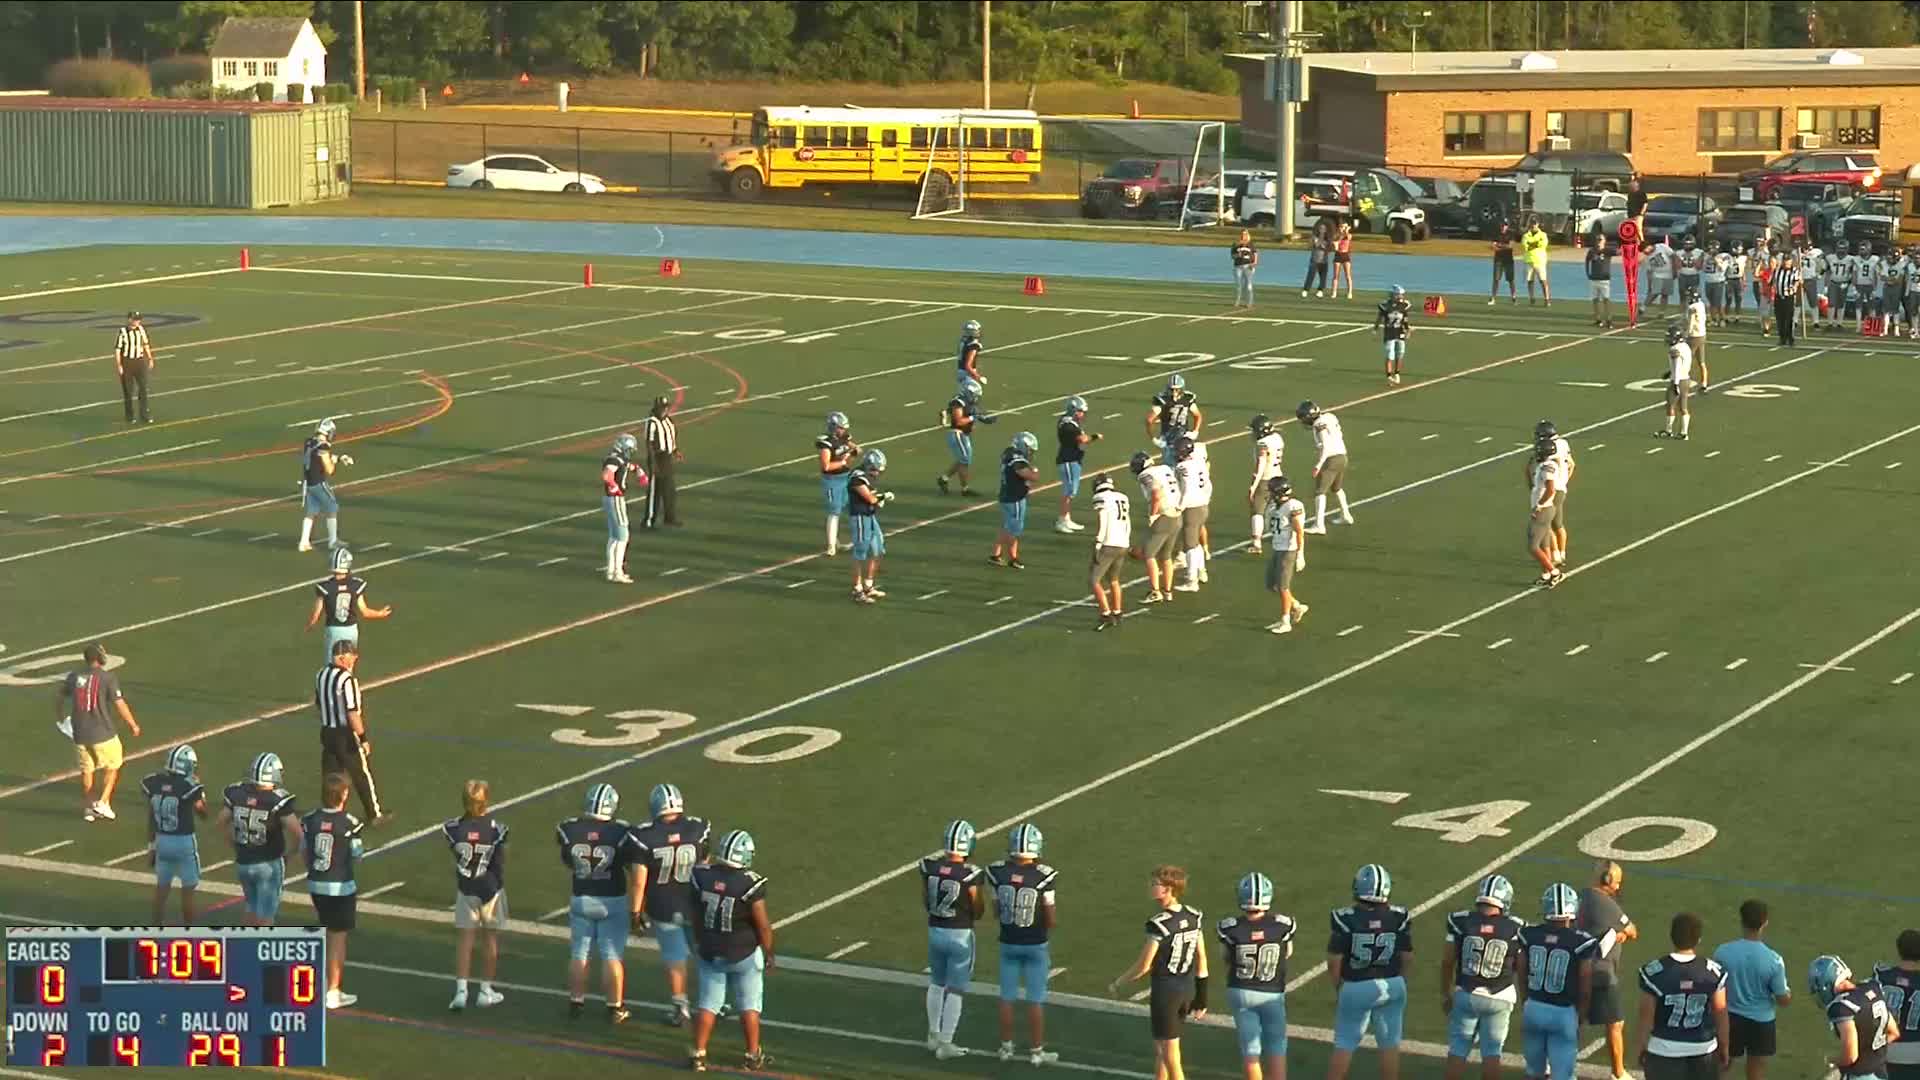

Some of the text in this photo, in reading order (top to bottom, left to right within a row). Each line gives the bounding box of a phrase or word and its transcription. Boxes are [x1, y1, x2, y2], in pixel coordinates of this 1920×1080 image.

[233, 806, 269, 846] 55
[313, 832, 335, 872] 9
[455, 842, 495, 879] 27
[653, 843, 697, 884] 70
[928, 875, 961, 918] 12
[1167, 929, 1199, 974] 17
[1236, 943, 1280, 982] 50
[1528, 945, 1570, 994] 90
[1871, 1000, 1888, 1050] 2
